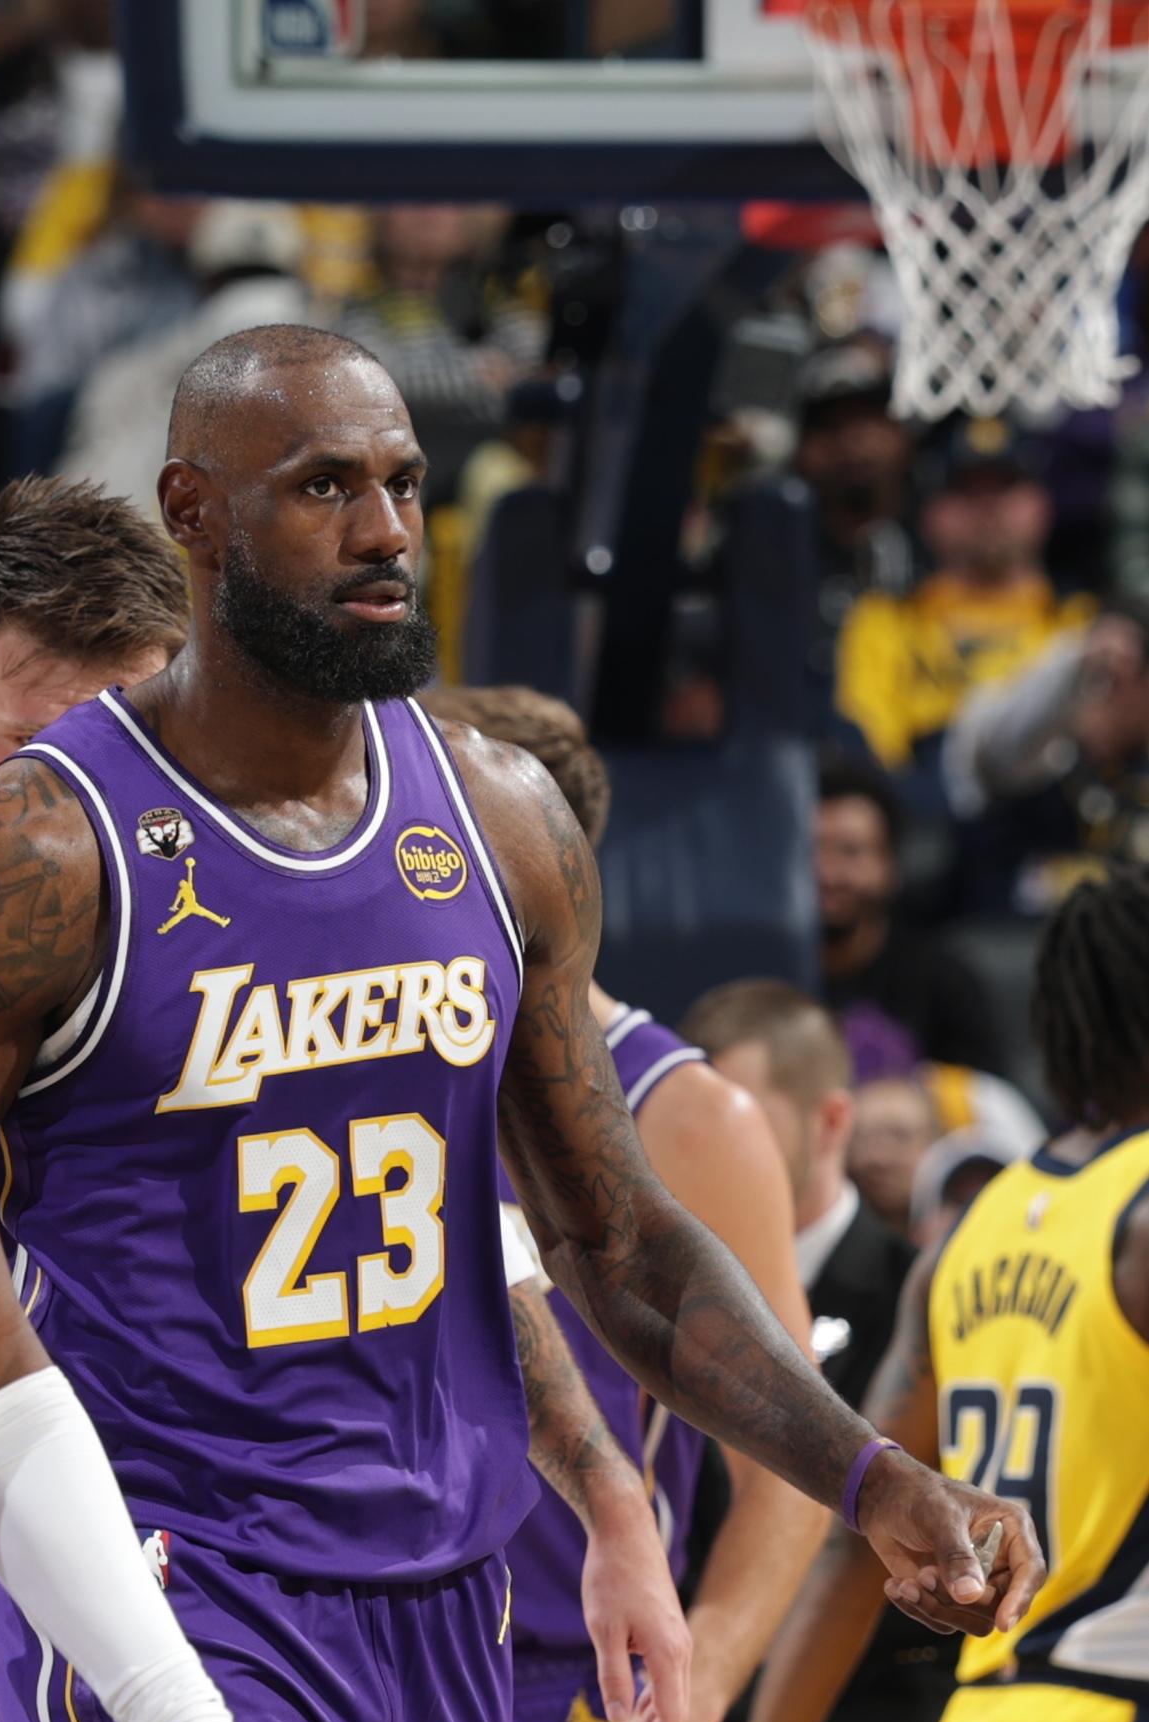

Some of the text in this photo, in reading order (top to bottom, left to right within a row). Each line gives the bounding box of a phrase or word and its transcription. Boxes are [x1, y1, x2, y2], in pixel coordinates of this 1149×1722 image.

[401, 846, 461, 878] bibigo
[155, 956, 495, 1115] LAKERS
[238, 1112, 446, 1349] 23
[950, 1253, 1080, 1342] JACKSON
